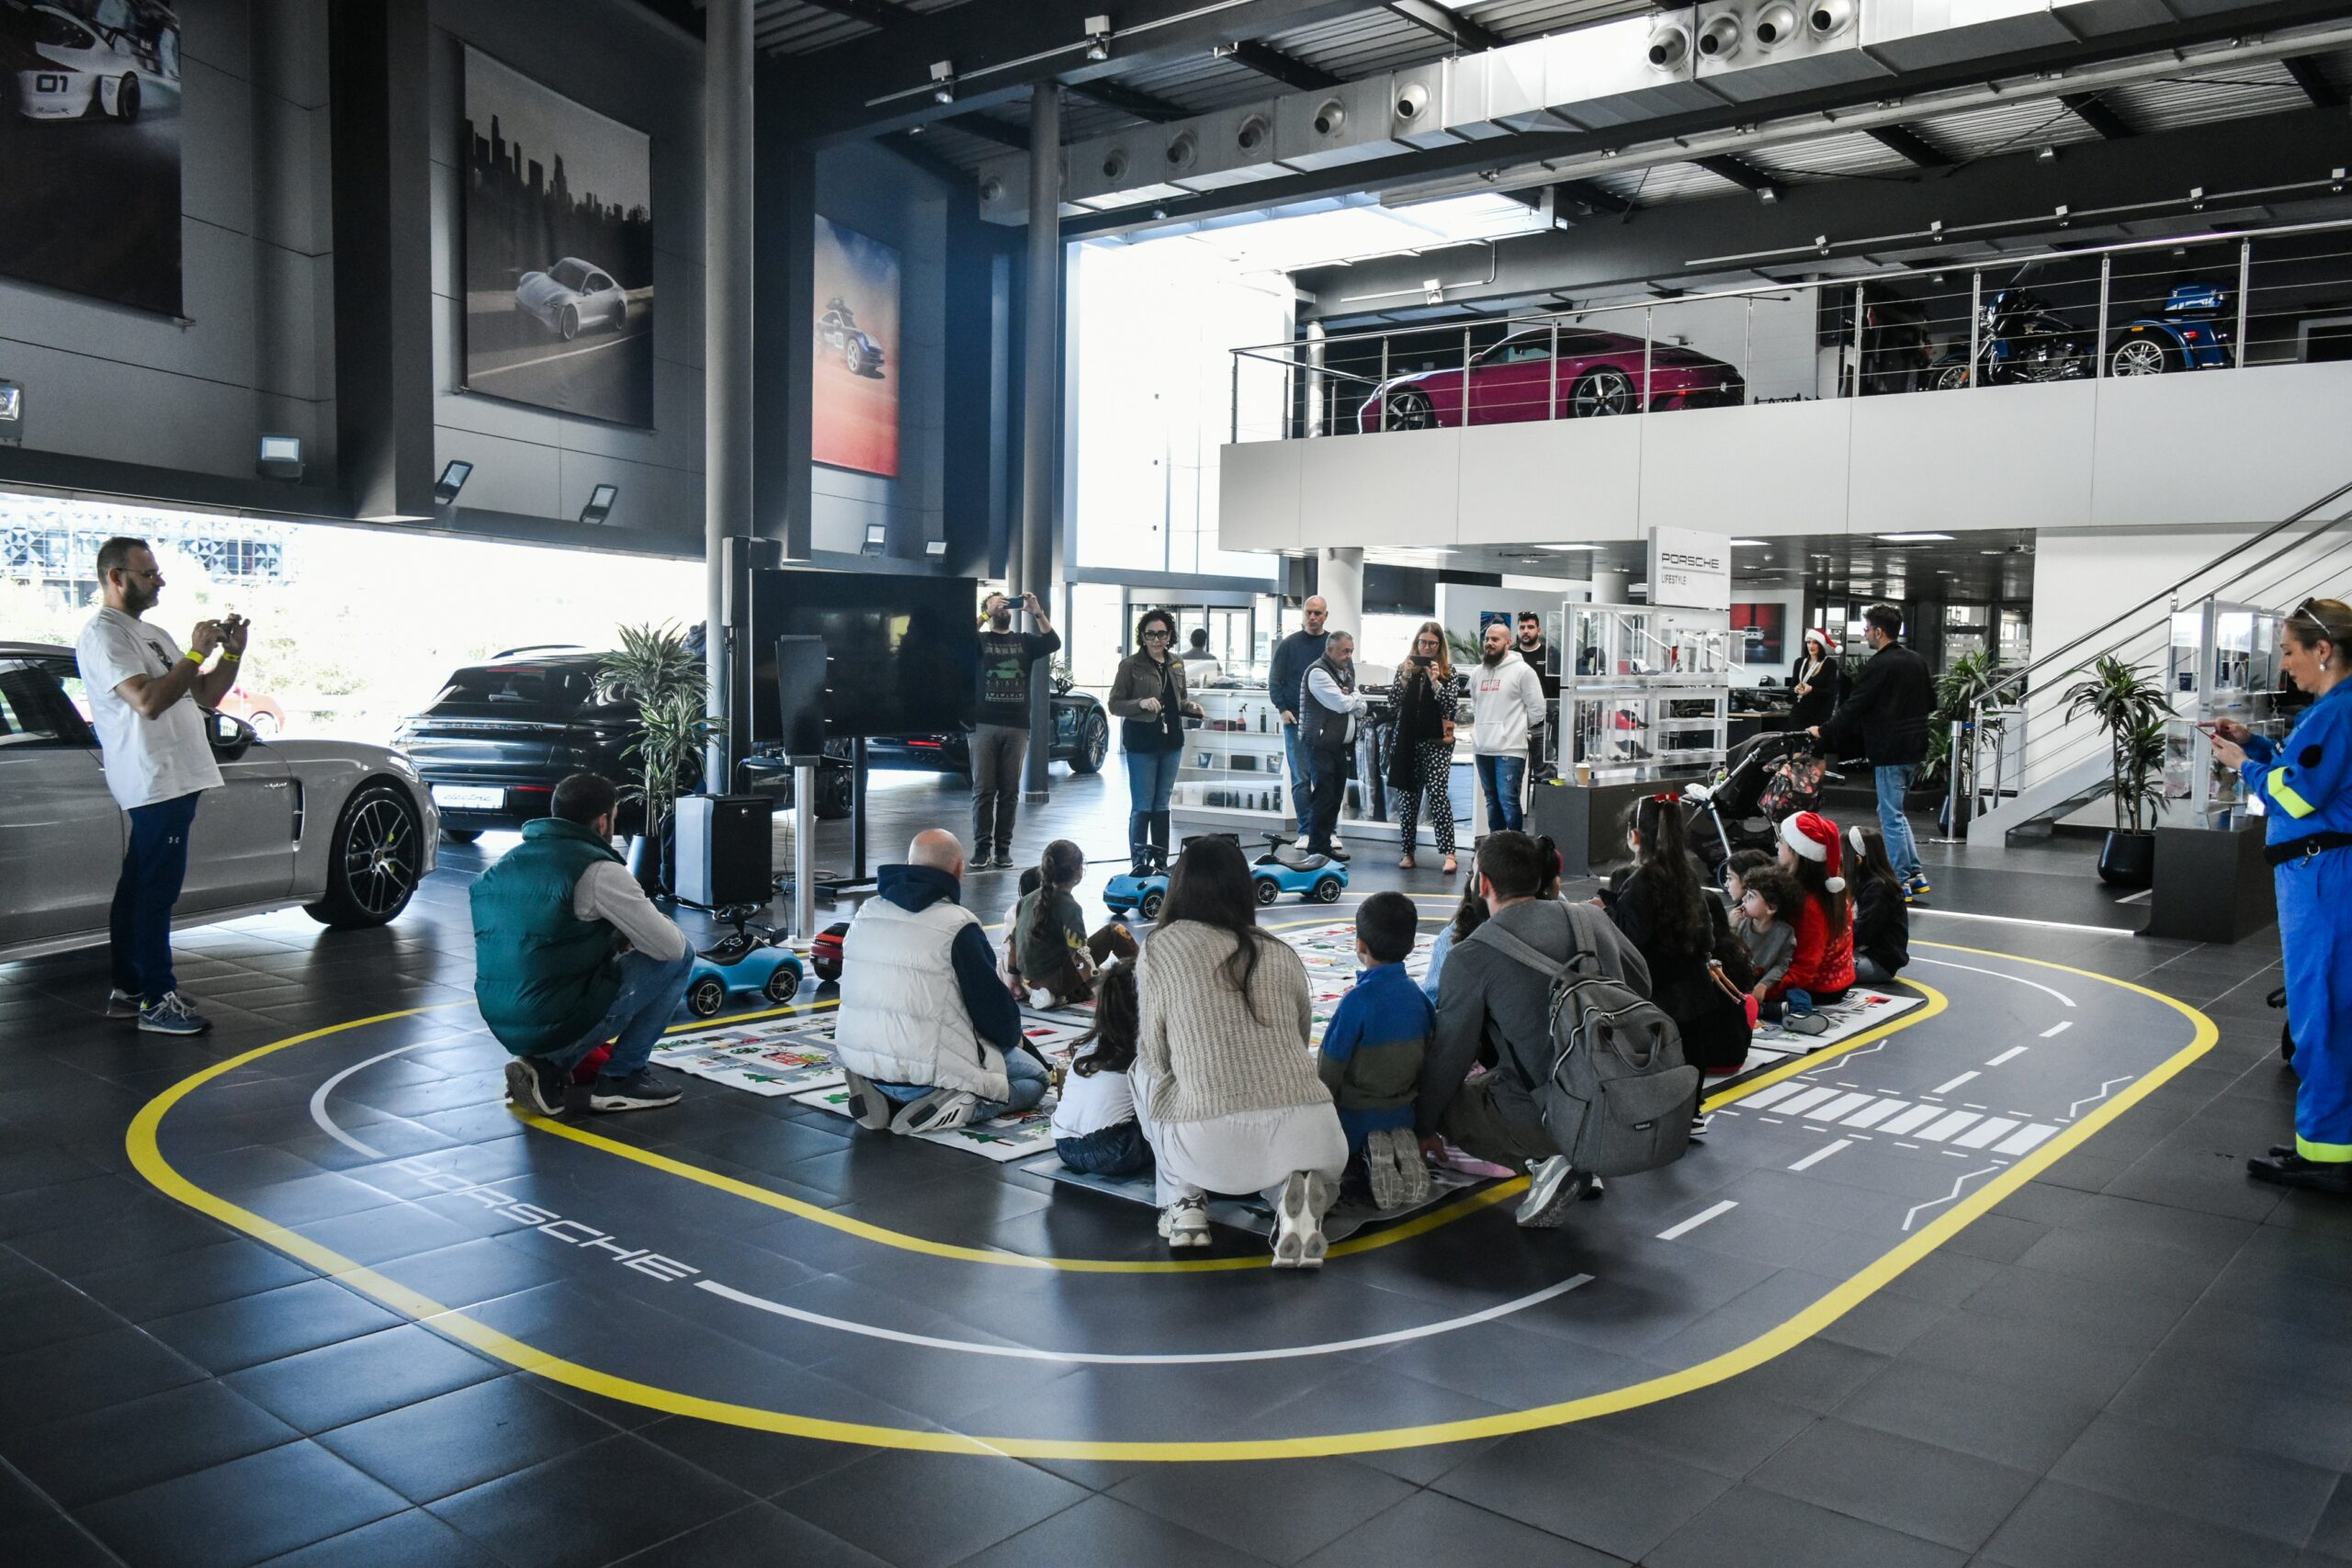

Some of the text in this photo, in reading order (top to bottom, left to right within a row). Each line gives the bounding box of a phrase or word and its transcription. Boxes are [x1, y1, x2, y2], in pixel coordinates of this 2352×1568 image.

[36, 74, 68, 92] 01
[1661, 553, 1720, 569] PORSCHE
[1661, 573, 1687, 585] LIFESTYLE
[443, 792, 492, 802] electric
[380, 1160, 702, 1282] PORSCHE
